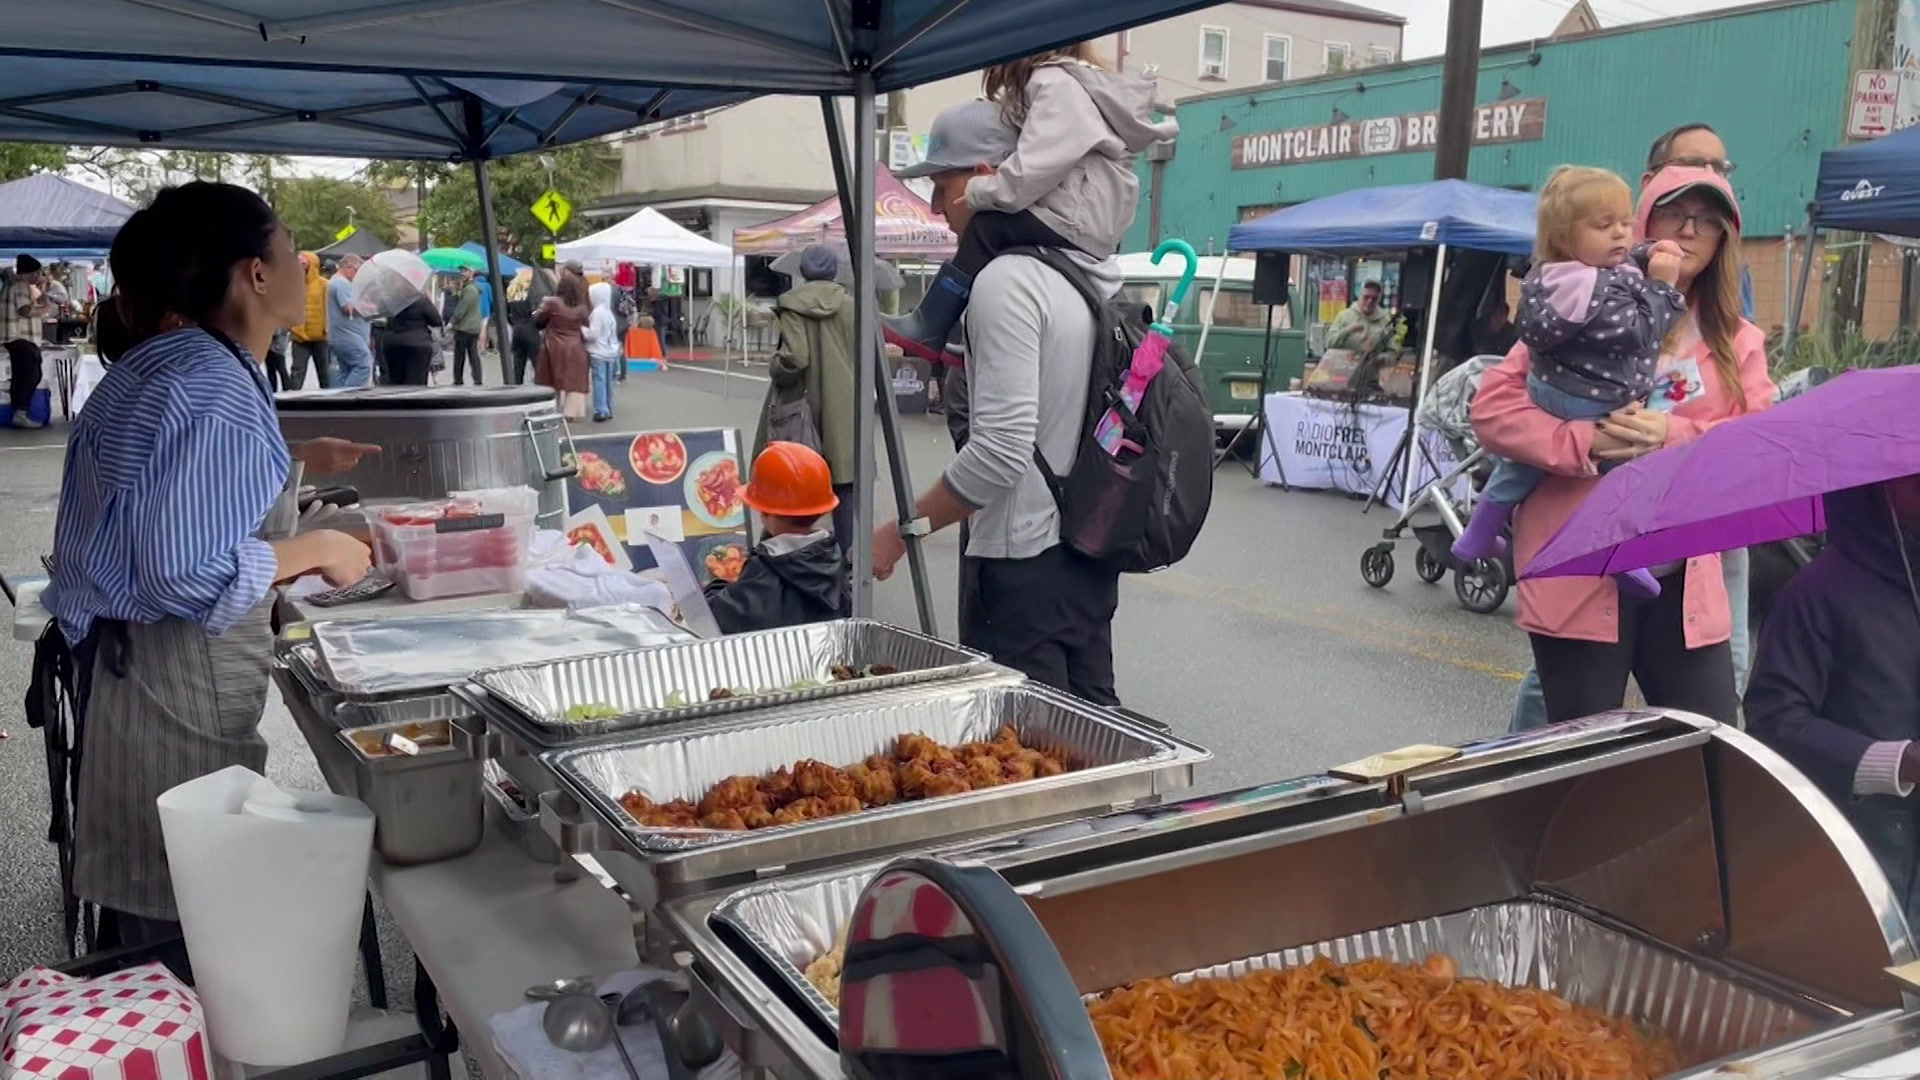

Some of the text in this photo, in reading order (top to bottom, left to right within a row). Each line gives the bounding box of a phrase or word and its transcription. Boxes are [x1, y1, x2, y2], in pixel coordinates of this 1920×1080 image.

[1869, 77, 1887, 90] NO
[1856, 92, 1895, 104] PARKING
[1864, 115, 1882, 123] TIME
[1242, 104, 1526, 164] MONTCLAIR BRERY
[1840, 184, 1886, 201] QUEST
[1295, 440, 1368, 461] MONTCLAIR
